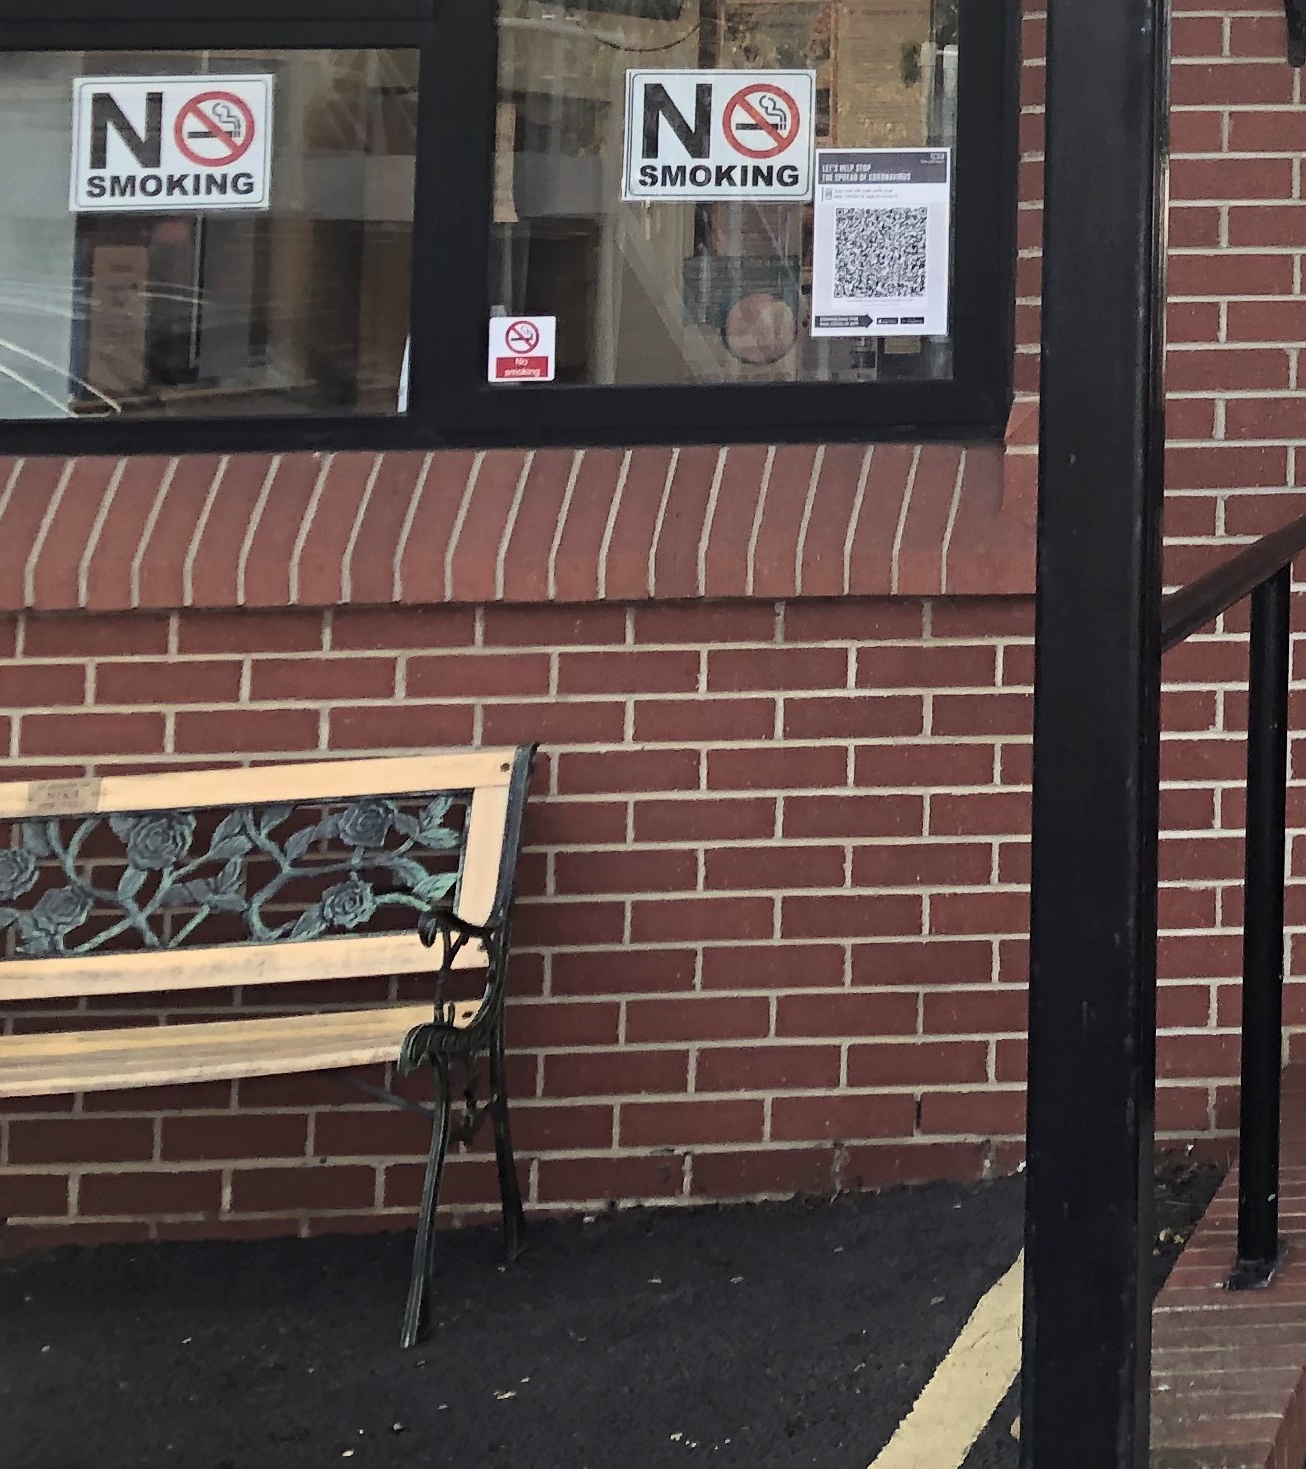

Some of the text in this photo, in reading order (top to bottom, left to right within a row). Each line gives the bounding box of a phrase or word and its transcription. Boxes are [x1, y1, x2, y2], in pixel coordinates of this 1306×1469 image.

[638, 164, 800, 188] SMOKING
[86, 172, 255, 198] SMOKING
[515, 357, 529, 366] No
[504, 368, 541, 378] smoking
